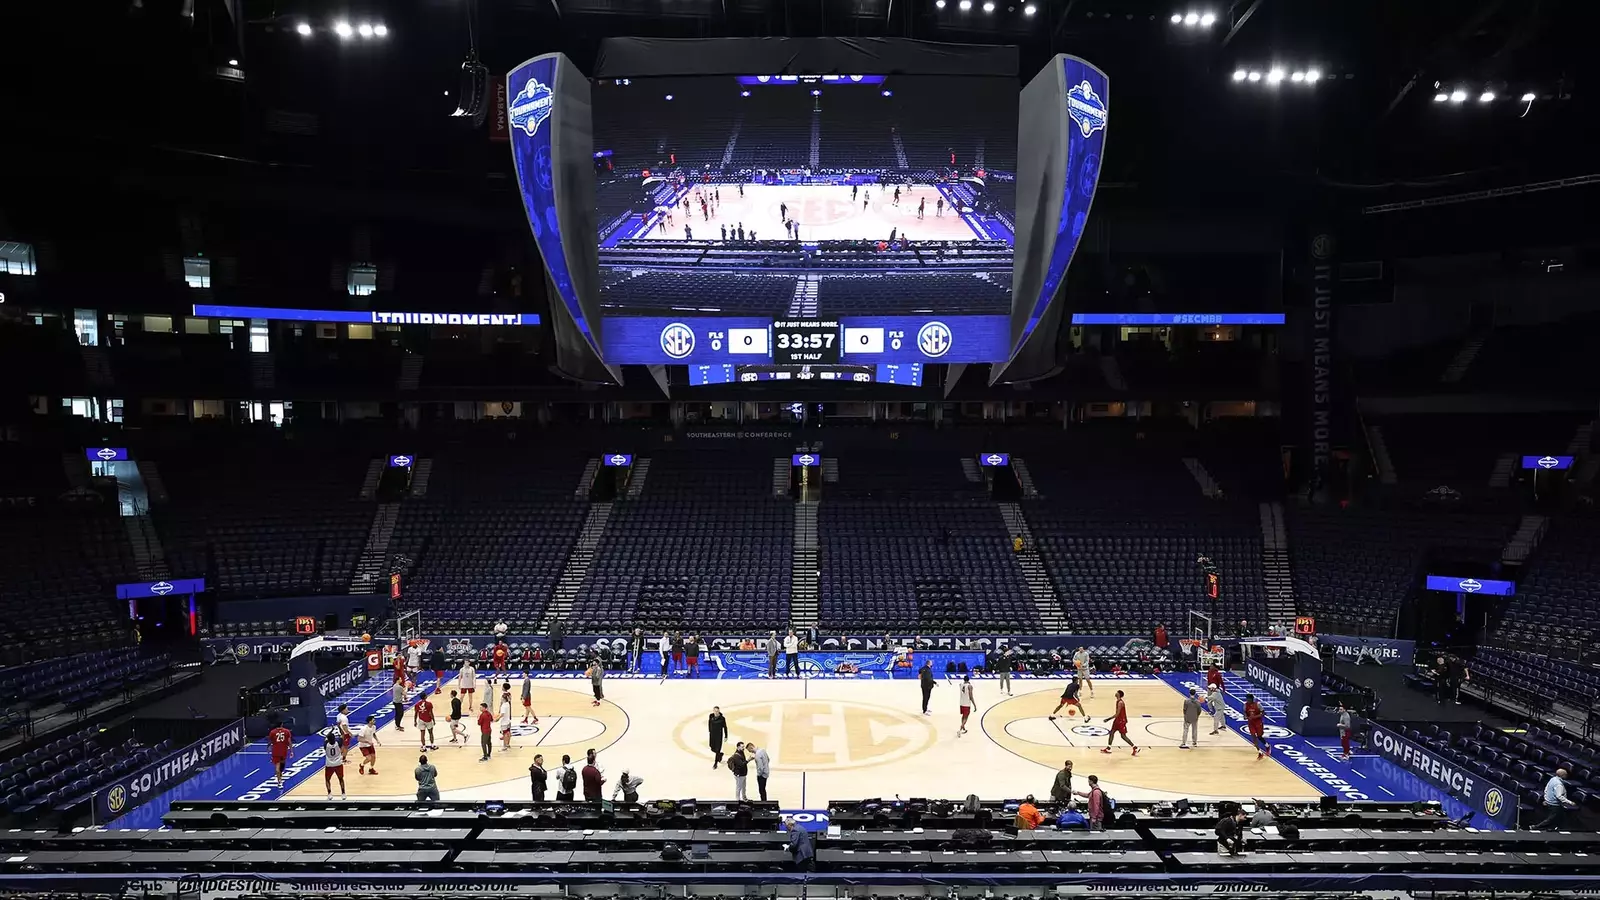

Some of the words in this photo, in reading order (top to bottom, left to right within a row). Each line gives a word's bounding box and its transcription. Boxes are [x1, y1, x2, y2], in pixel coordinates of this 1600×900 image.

[497, 83, 505, 131] ALABAMA
[1314, 286, 1330, 331] JUST
[1173, 313, 1222, 323] #SECMBB
[664, 326, 691, 355] SEC
[744, 335, 752, 345] 0
[777, 333, 835, 349] 33:57
[860, 335, 869, 345] 0
[889, 330, 904, 338] FLS
[920, 325, 948, 353] SEC
[711, 339, 721, 351] 0
[891, 338, 901, 350] 0
[1313, 337, 1330, 404] MEANS
[1334, 645, 1359, 656] ANS
[368, 653, 379, 666] G
[1247, 663, 1294, 697] SOUTHEAS
[276, 732, 285, 742] 25
[330, 747, 336, 757] 0
[131, 727, 239, 798] SOUTHEASTERN
[1372, 729, 1473, 798] CONFERENCE
[1273, 743, 1369, 800] CONFERENC
[108, 787, 126, 811] SEC
[1485, 789, 1503, 815] SEC
[179, 880, 281, 892] BRIDGESTONE
